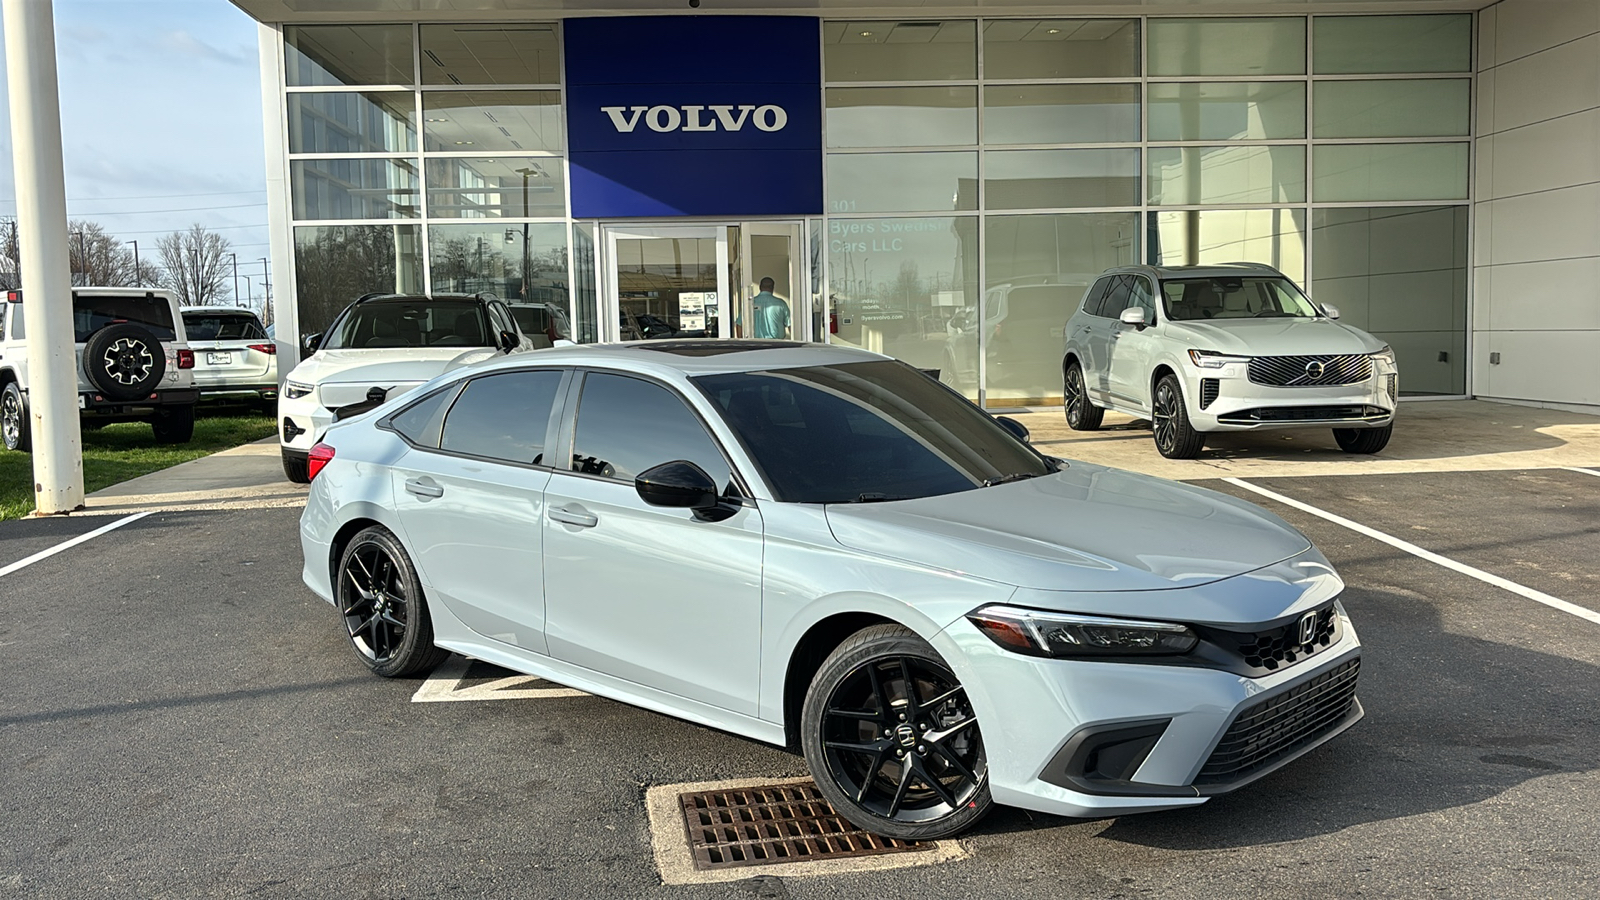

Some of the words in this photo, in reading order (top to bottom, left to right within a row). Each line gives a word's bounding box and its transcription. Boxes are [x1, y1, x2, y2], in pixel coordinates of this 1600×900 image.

[601, 105, 788, 133] VOLVO
[830, 200, 857, 212] 301
[830, 221, 875, 238] Byers
[830, 240, 867, 253] Cars
[873, 238, 903, 252] LLC
